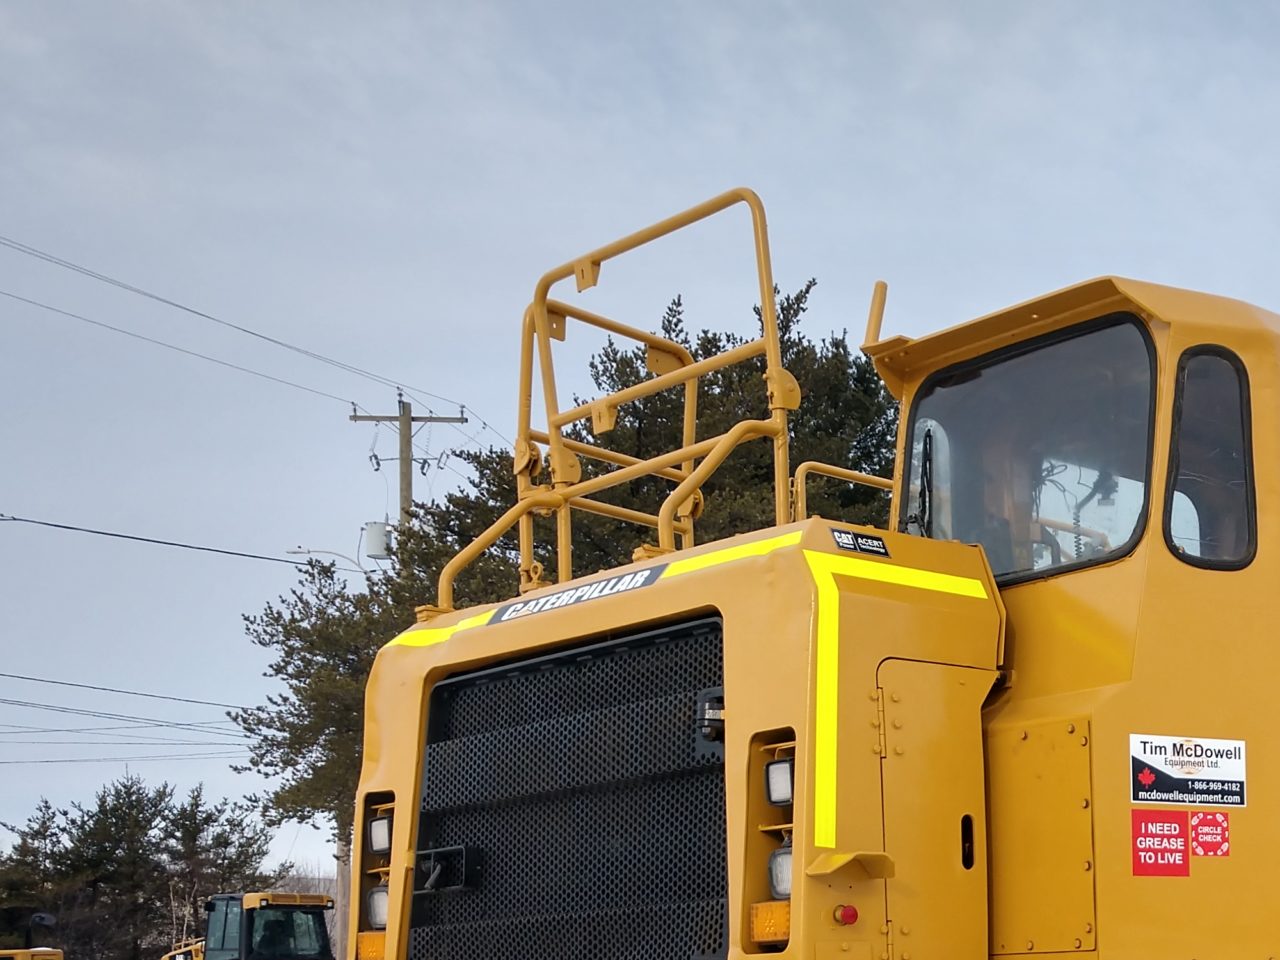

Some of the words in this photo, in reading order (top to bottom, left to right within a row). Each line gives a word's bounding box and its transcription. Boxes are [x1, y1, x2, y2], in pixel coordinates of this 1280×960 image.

[833, 531, 854, 544] CAT
[858, 537, 883, 548] ACERT
[501, 569, 651, 621] CATERPILLAR
[1140, 740, 1167, 755] Tim
[1172, 743, 1241, 760] McDowell
[1164, 757, 1205, 768] Equipment
[1206, 760, 1220, 768] Ltd.
[1187, 781, 1241, 791] 1-866-969-4182
[1138, 789, 1241, 804] mcdowellequipment.com
[1141, 822, 1145, 834] I
[1148, 823, 1180, 835] NEED
[1198, 826, 1222, 834] CIRCLE
[1136, 837, 1185, 850] GREASE
[1139, 852, 1155, 863] TO
[1158, 853, 1184, 864] LIVE
